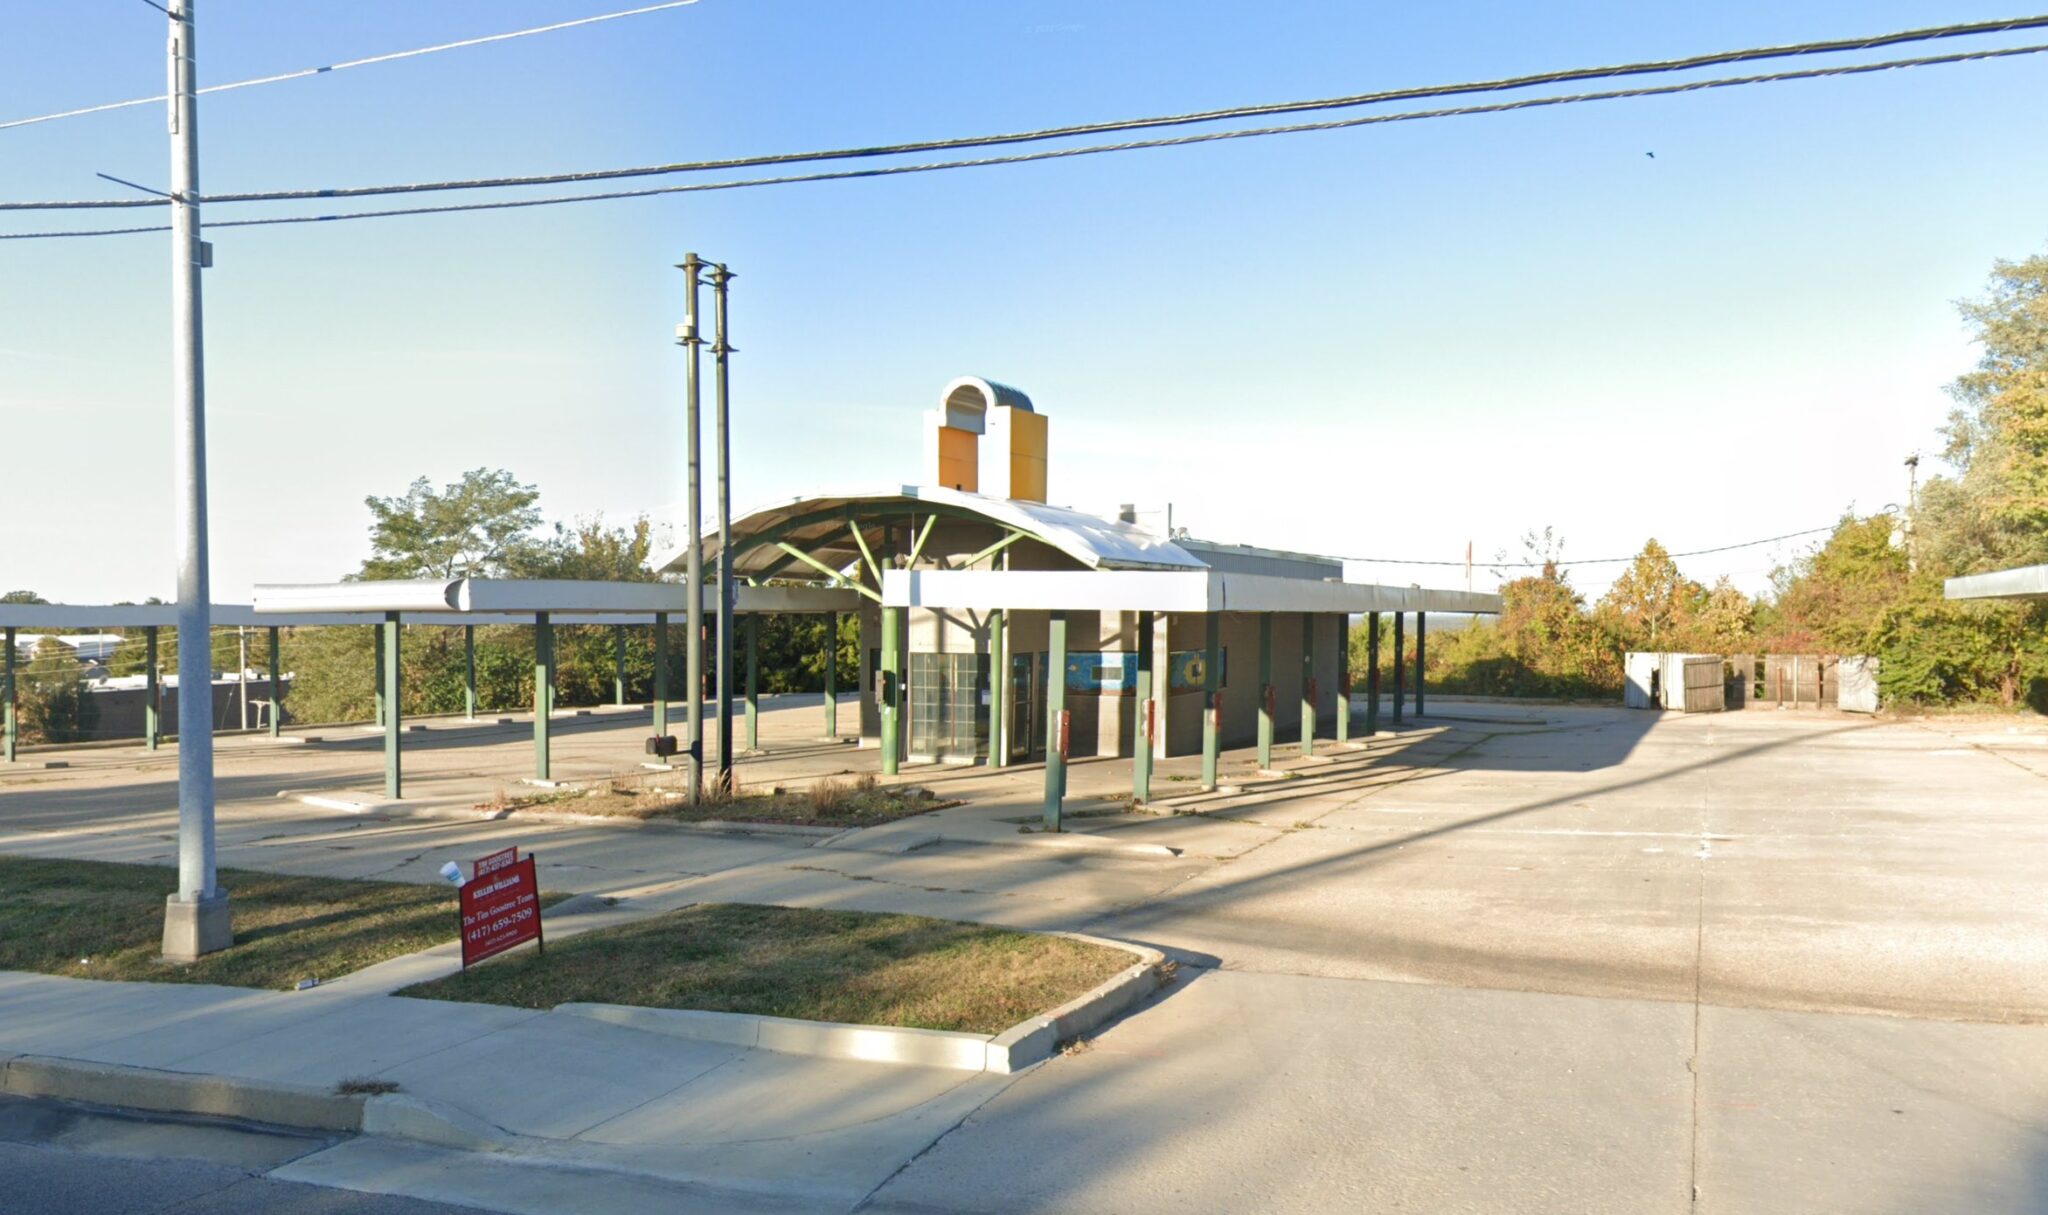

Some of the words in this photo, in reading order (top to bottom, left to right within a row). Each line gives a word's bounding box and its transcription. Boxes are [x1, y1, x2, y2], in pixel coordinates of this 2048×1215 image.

[473, 885, 494, 899] KELLER
[494, 875, 520, 890] WILLIAMS
[463, 915, 476, 926] The
[477, 911, 489, 922] Tim
[517, 893, 535, 905] Team
[467, 923, 491, 943] (417)
[492, 908, 533, 932] 659-7509
